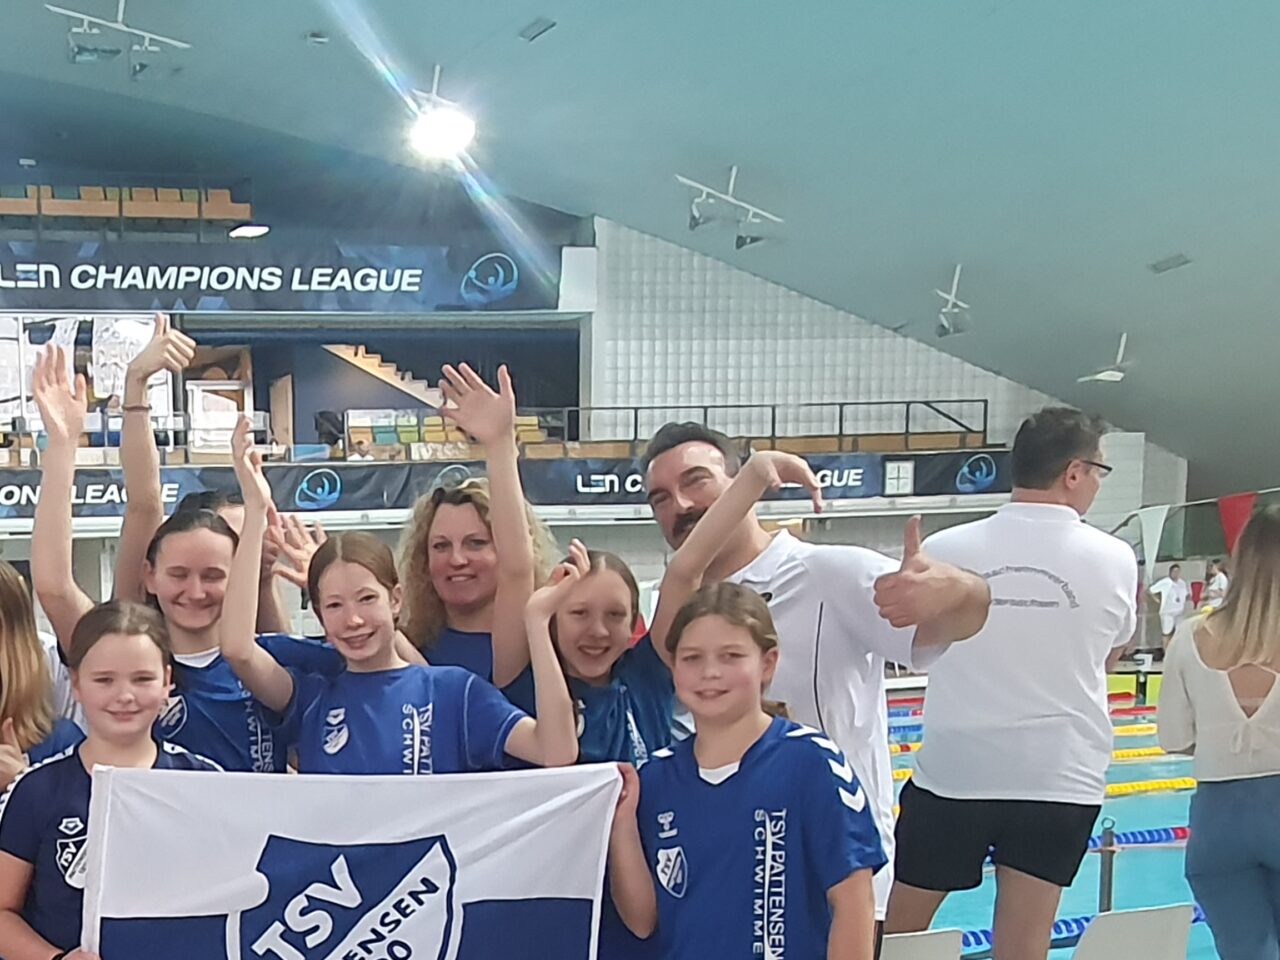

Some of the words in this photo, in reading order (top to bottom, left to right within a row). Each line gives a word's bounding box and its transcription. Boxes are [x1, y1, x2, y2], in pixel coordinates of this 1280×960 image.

[70, 263, 283, 292] CHAMPIONS
[291, 268, 422, 292] LEAGUE
[71, 483, 179, 505] LEAE
[403, 703, 413, 774] SCHWI
[771, 808, 787, 845] TSV
[768, 850, 786, 960] PATTENSEN
